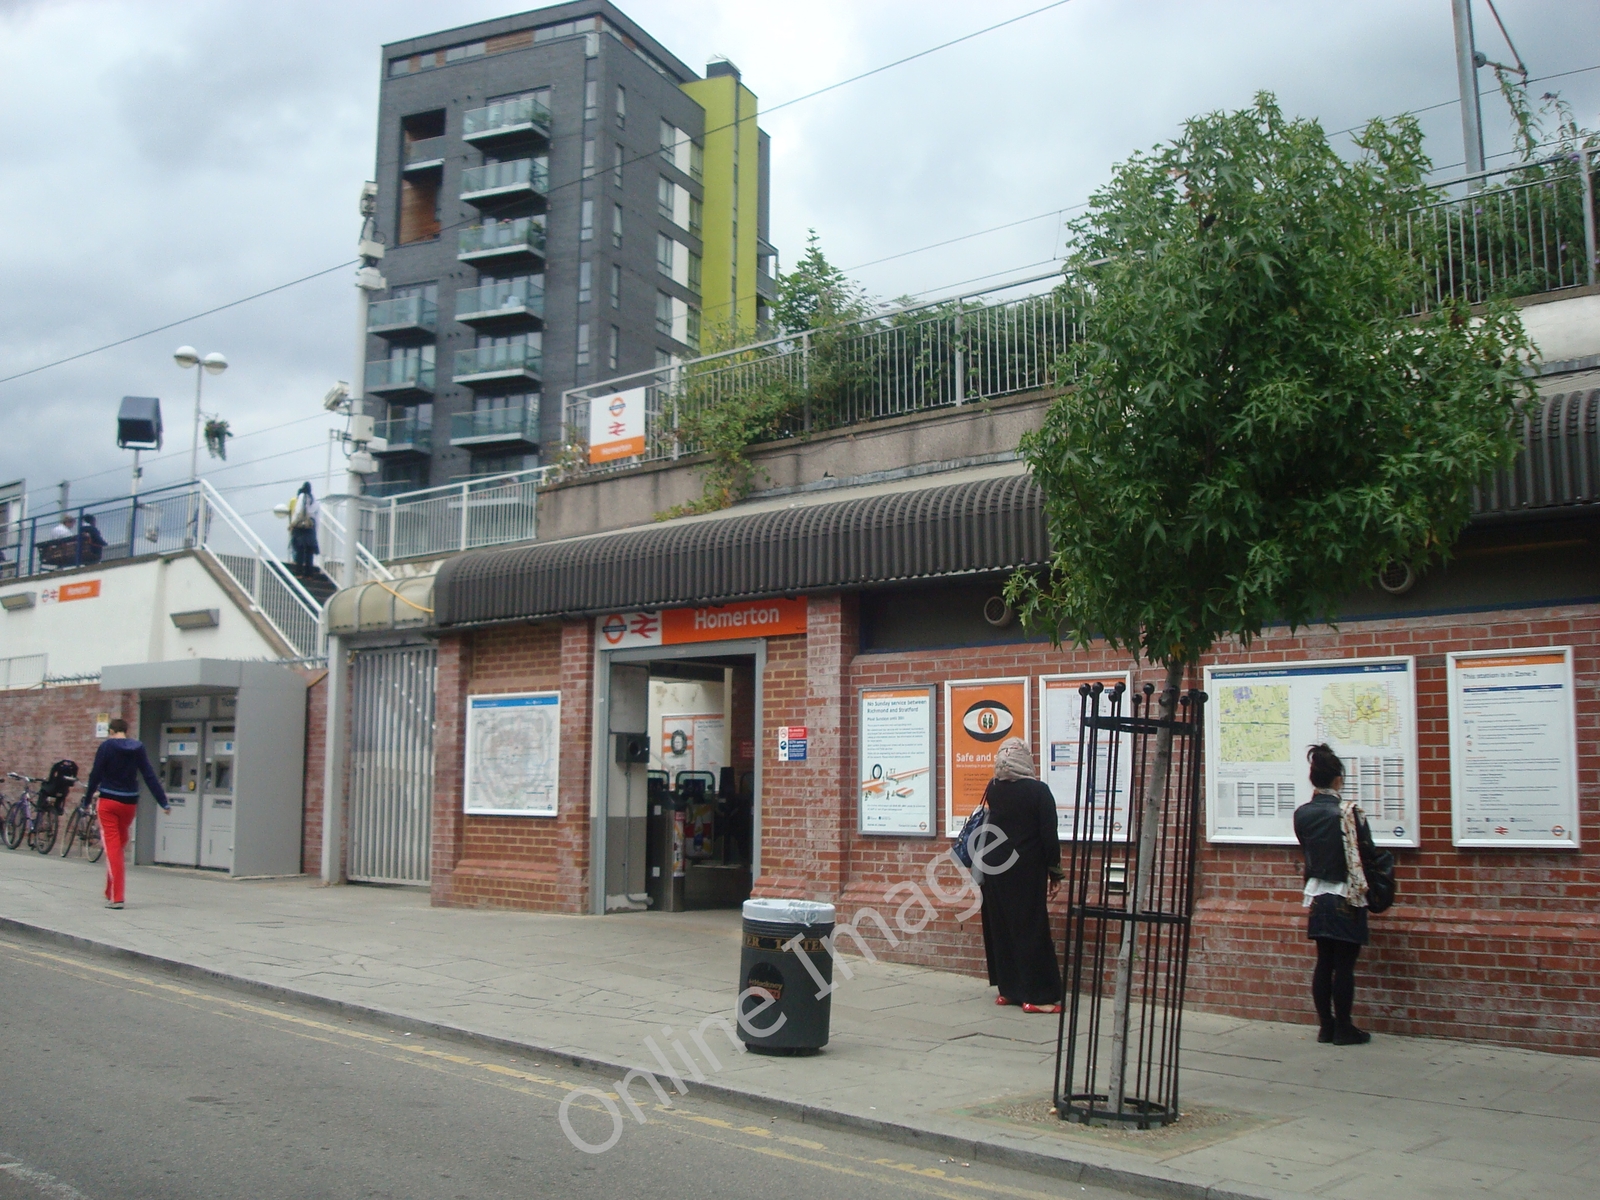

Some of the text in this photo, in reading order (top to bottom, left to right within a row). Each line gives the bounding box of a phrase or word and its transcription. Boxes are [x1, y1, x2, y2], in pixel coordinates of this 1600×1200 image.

[694, 607, 779, 630] Homerton
[956, 752, 974, 762] Safe
[975, 752, 992, 762] and
